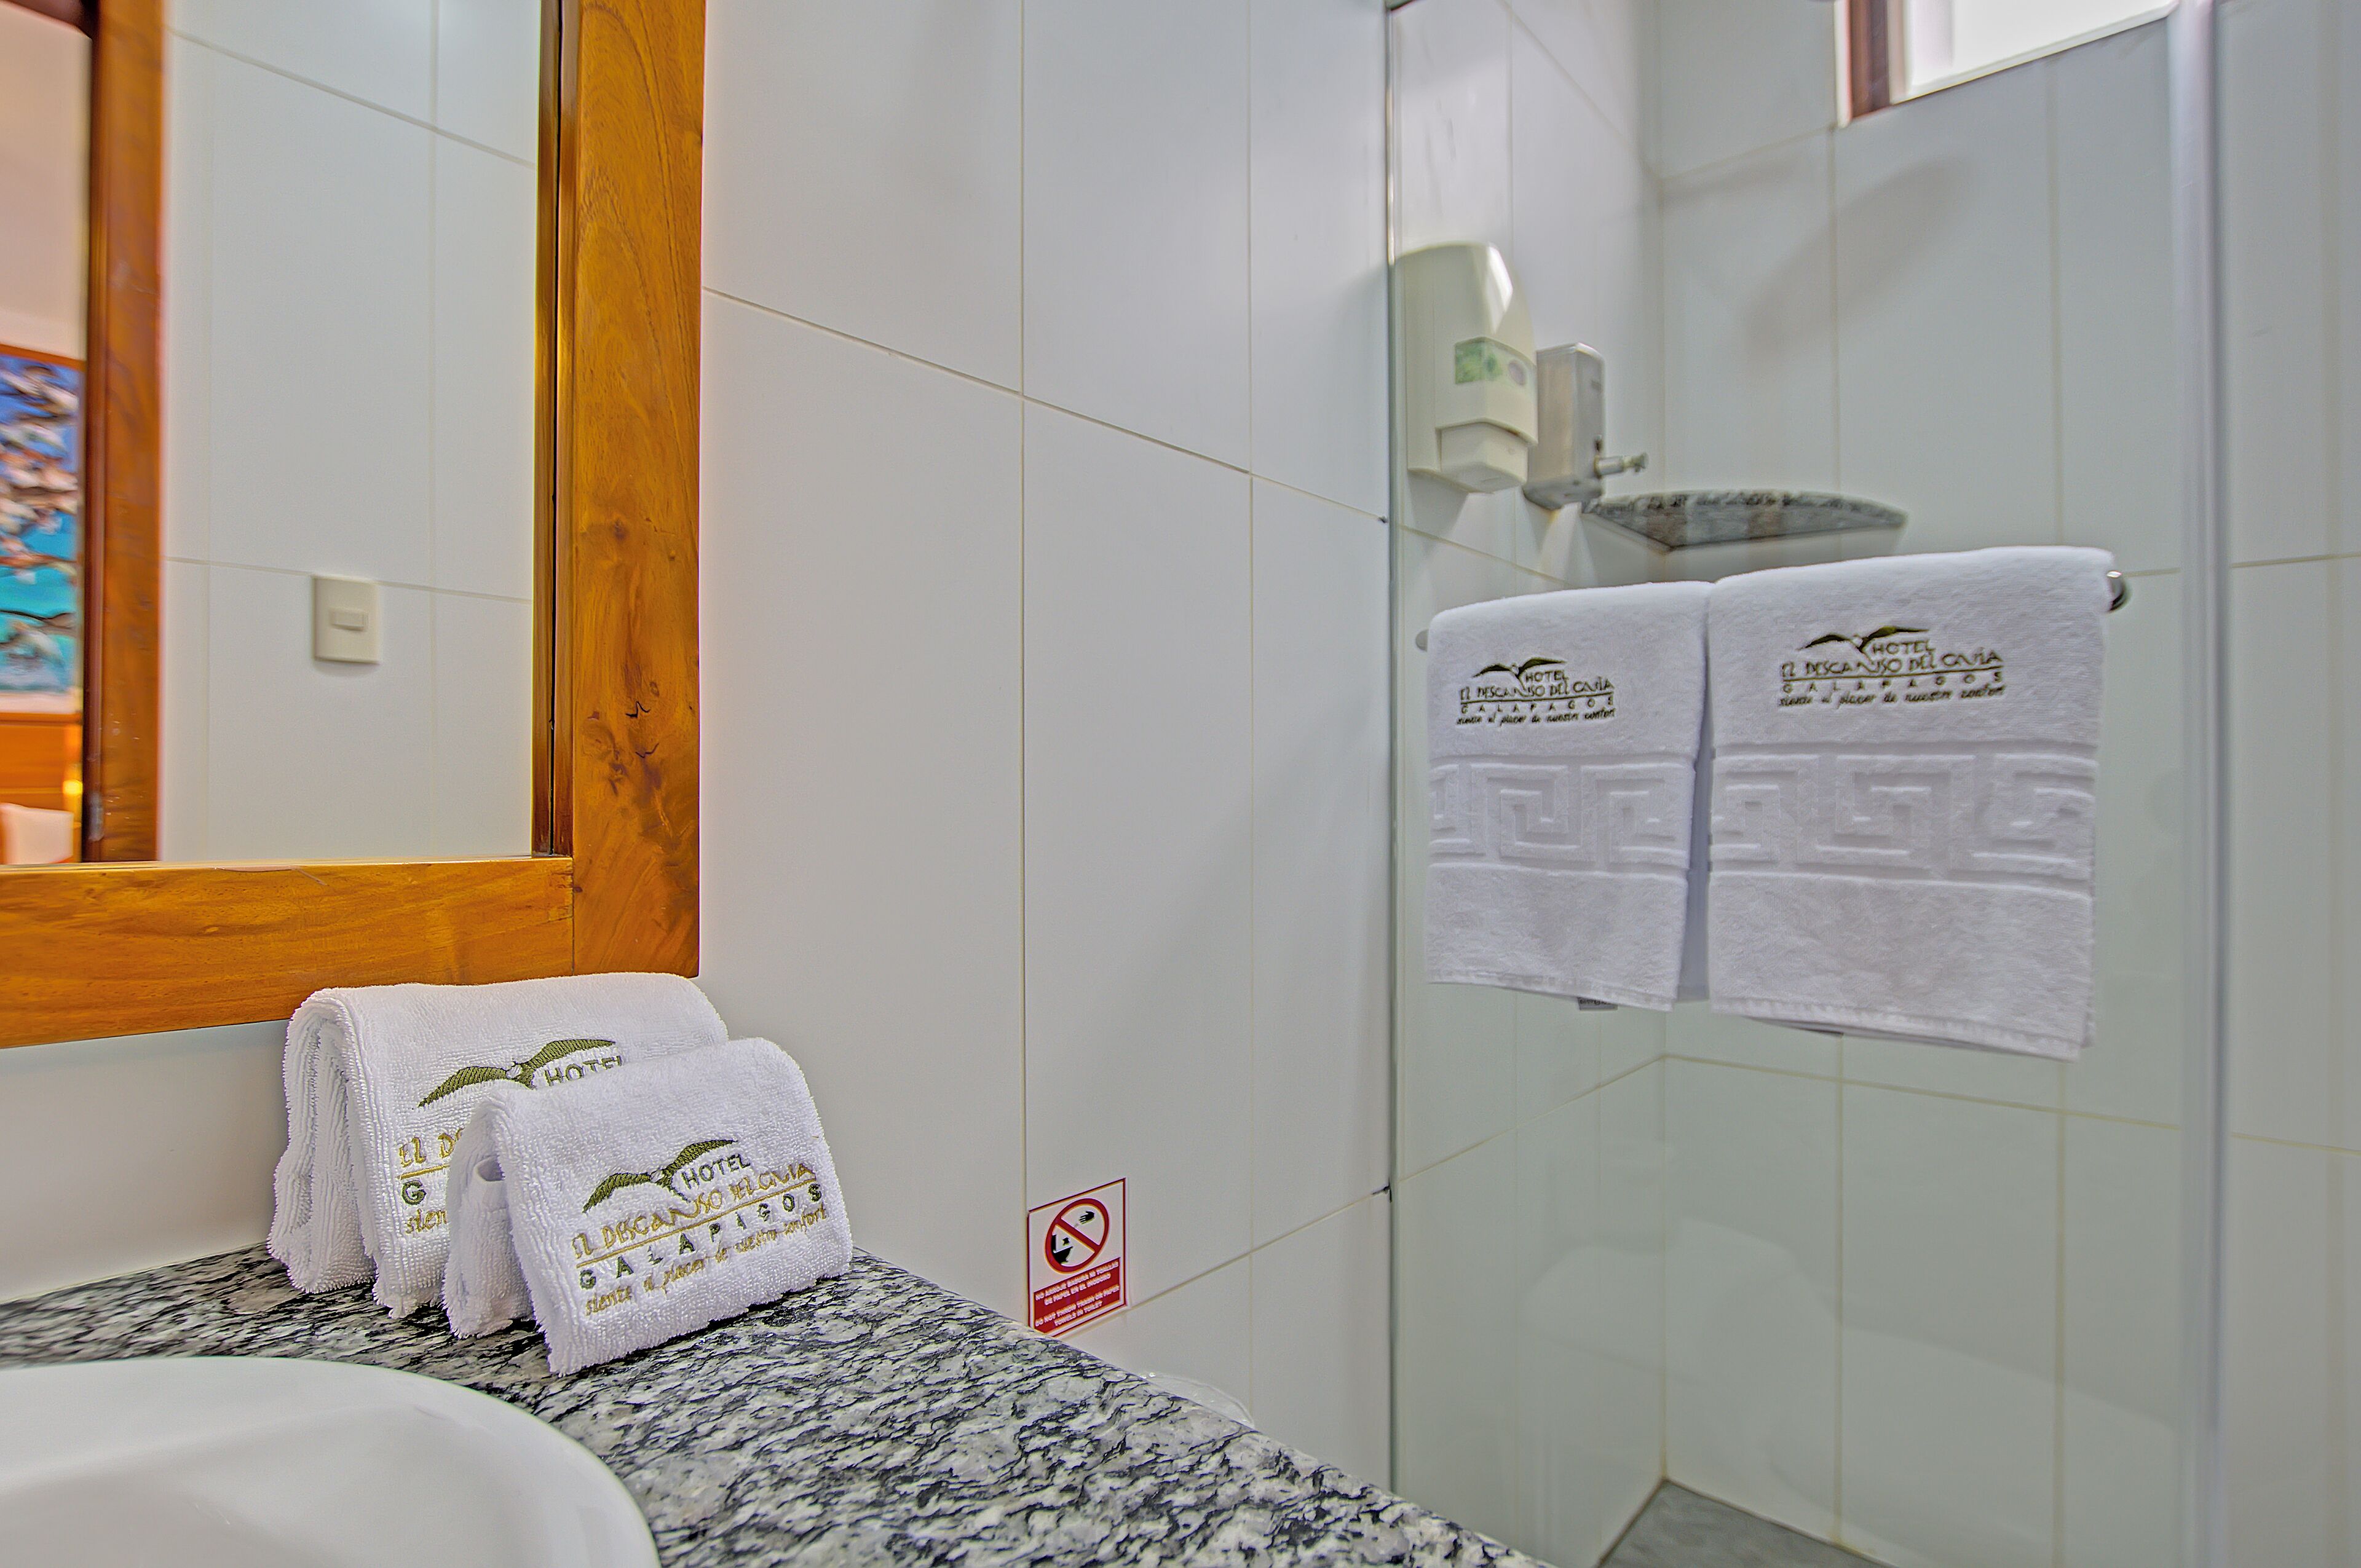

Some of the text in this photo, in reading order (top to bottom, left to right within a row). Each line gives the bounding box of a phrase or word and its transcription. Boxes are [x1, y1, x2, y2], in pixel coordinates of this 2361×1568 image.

[1872, 639, 1936, 655] HOTEL
[1525, 669, 1568, 682] HOTEL
[1783, 672, 2003, 693] GALAPAGOS
[1461, 695, 1613, 714] GALAPAGOS
[681, 1154, 751, 1189] HOTEL
[579, 1183, 822, 1290] GALAPAGOS
[1035, 1291, 1045, 1301] NO
[1044, 1312, 1056, 1322] NOT
